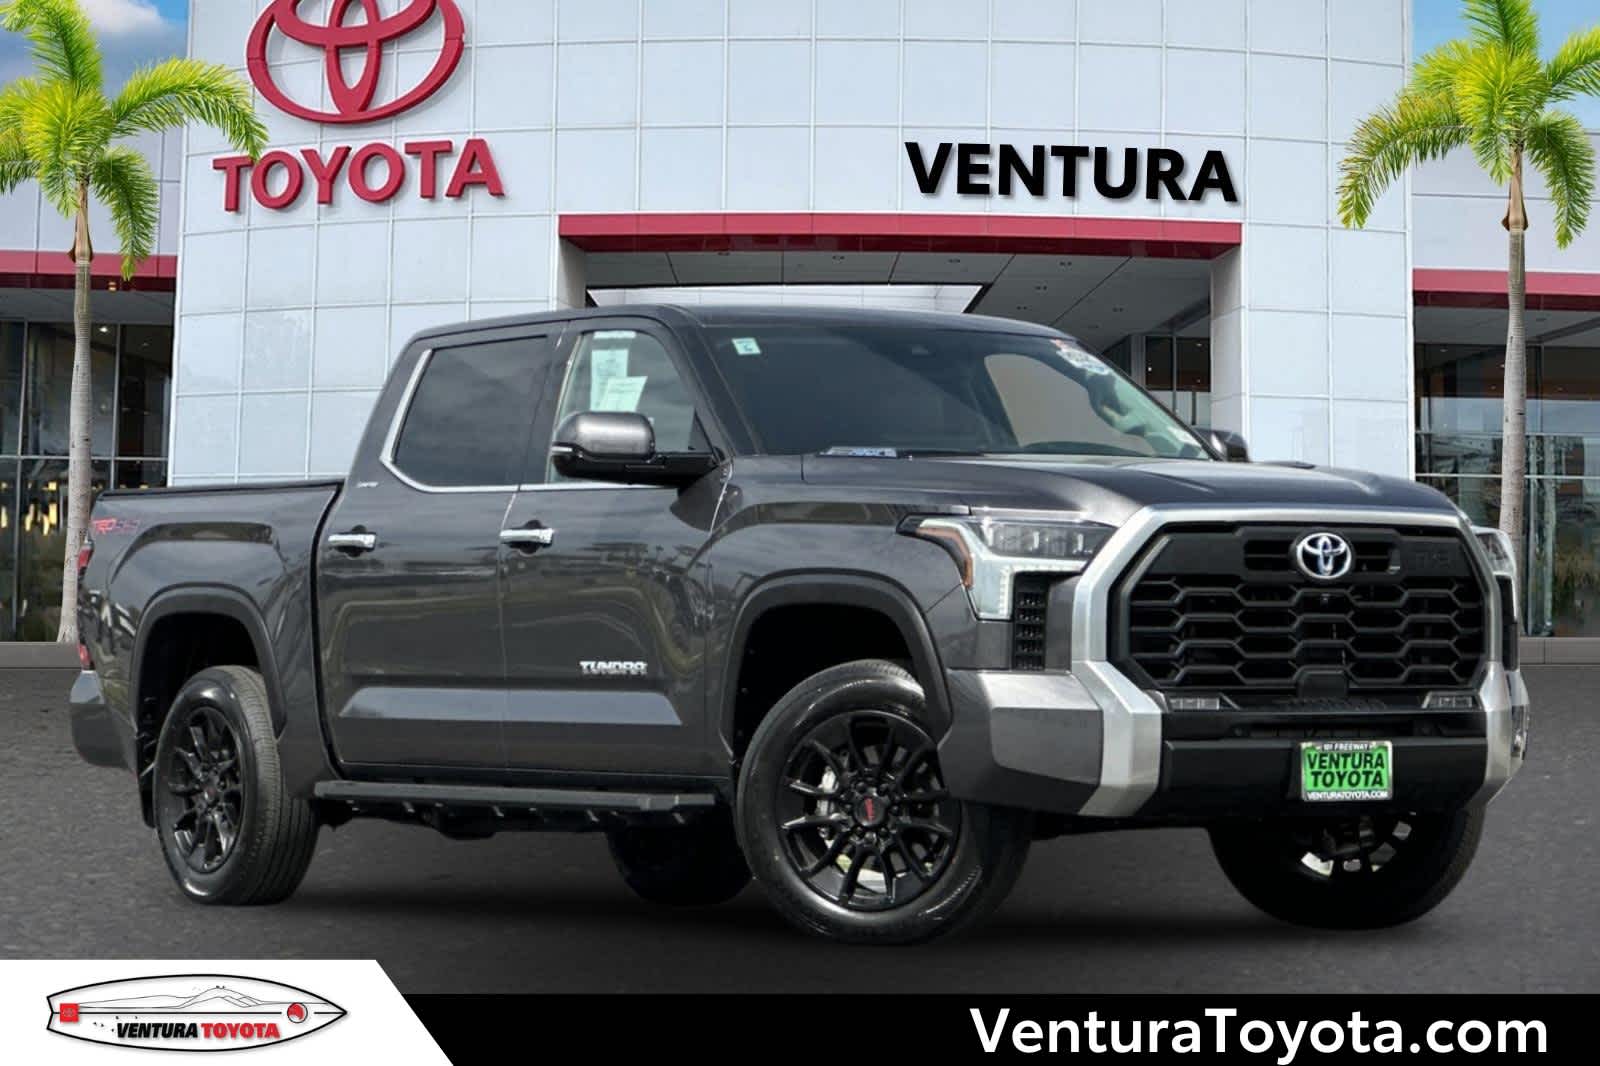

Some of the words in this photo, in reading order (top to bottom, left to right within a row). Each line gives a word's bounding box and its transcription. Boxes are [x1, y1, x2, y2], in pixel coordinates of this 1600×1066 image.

[213, 138, 505, 212] TOYOTA
[904, 141, 1239, 202] VENTURA
[1334, 742, 1369, 751] FREEWAY
[1307, 752, 1385, 770] VENTURA
[1311, 770, 1384, 788] TOYOTA
[1306, 790, 1388, 800] VENTURATOYOTA.COM
